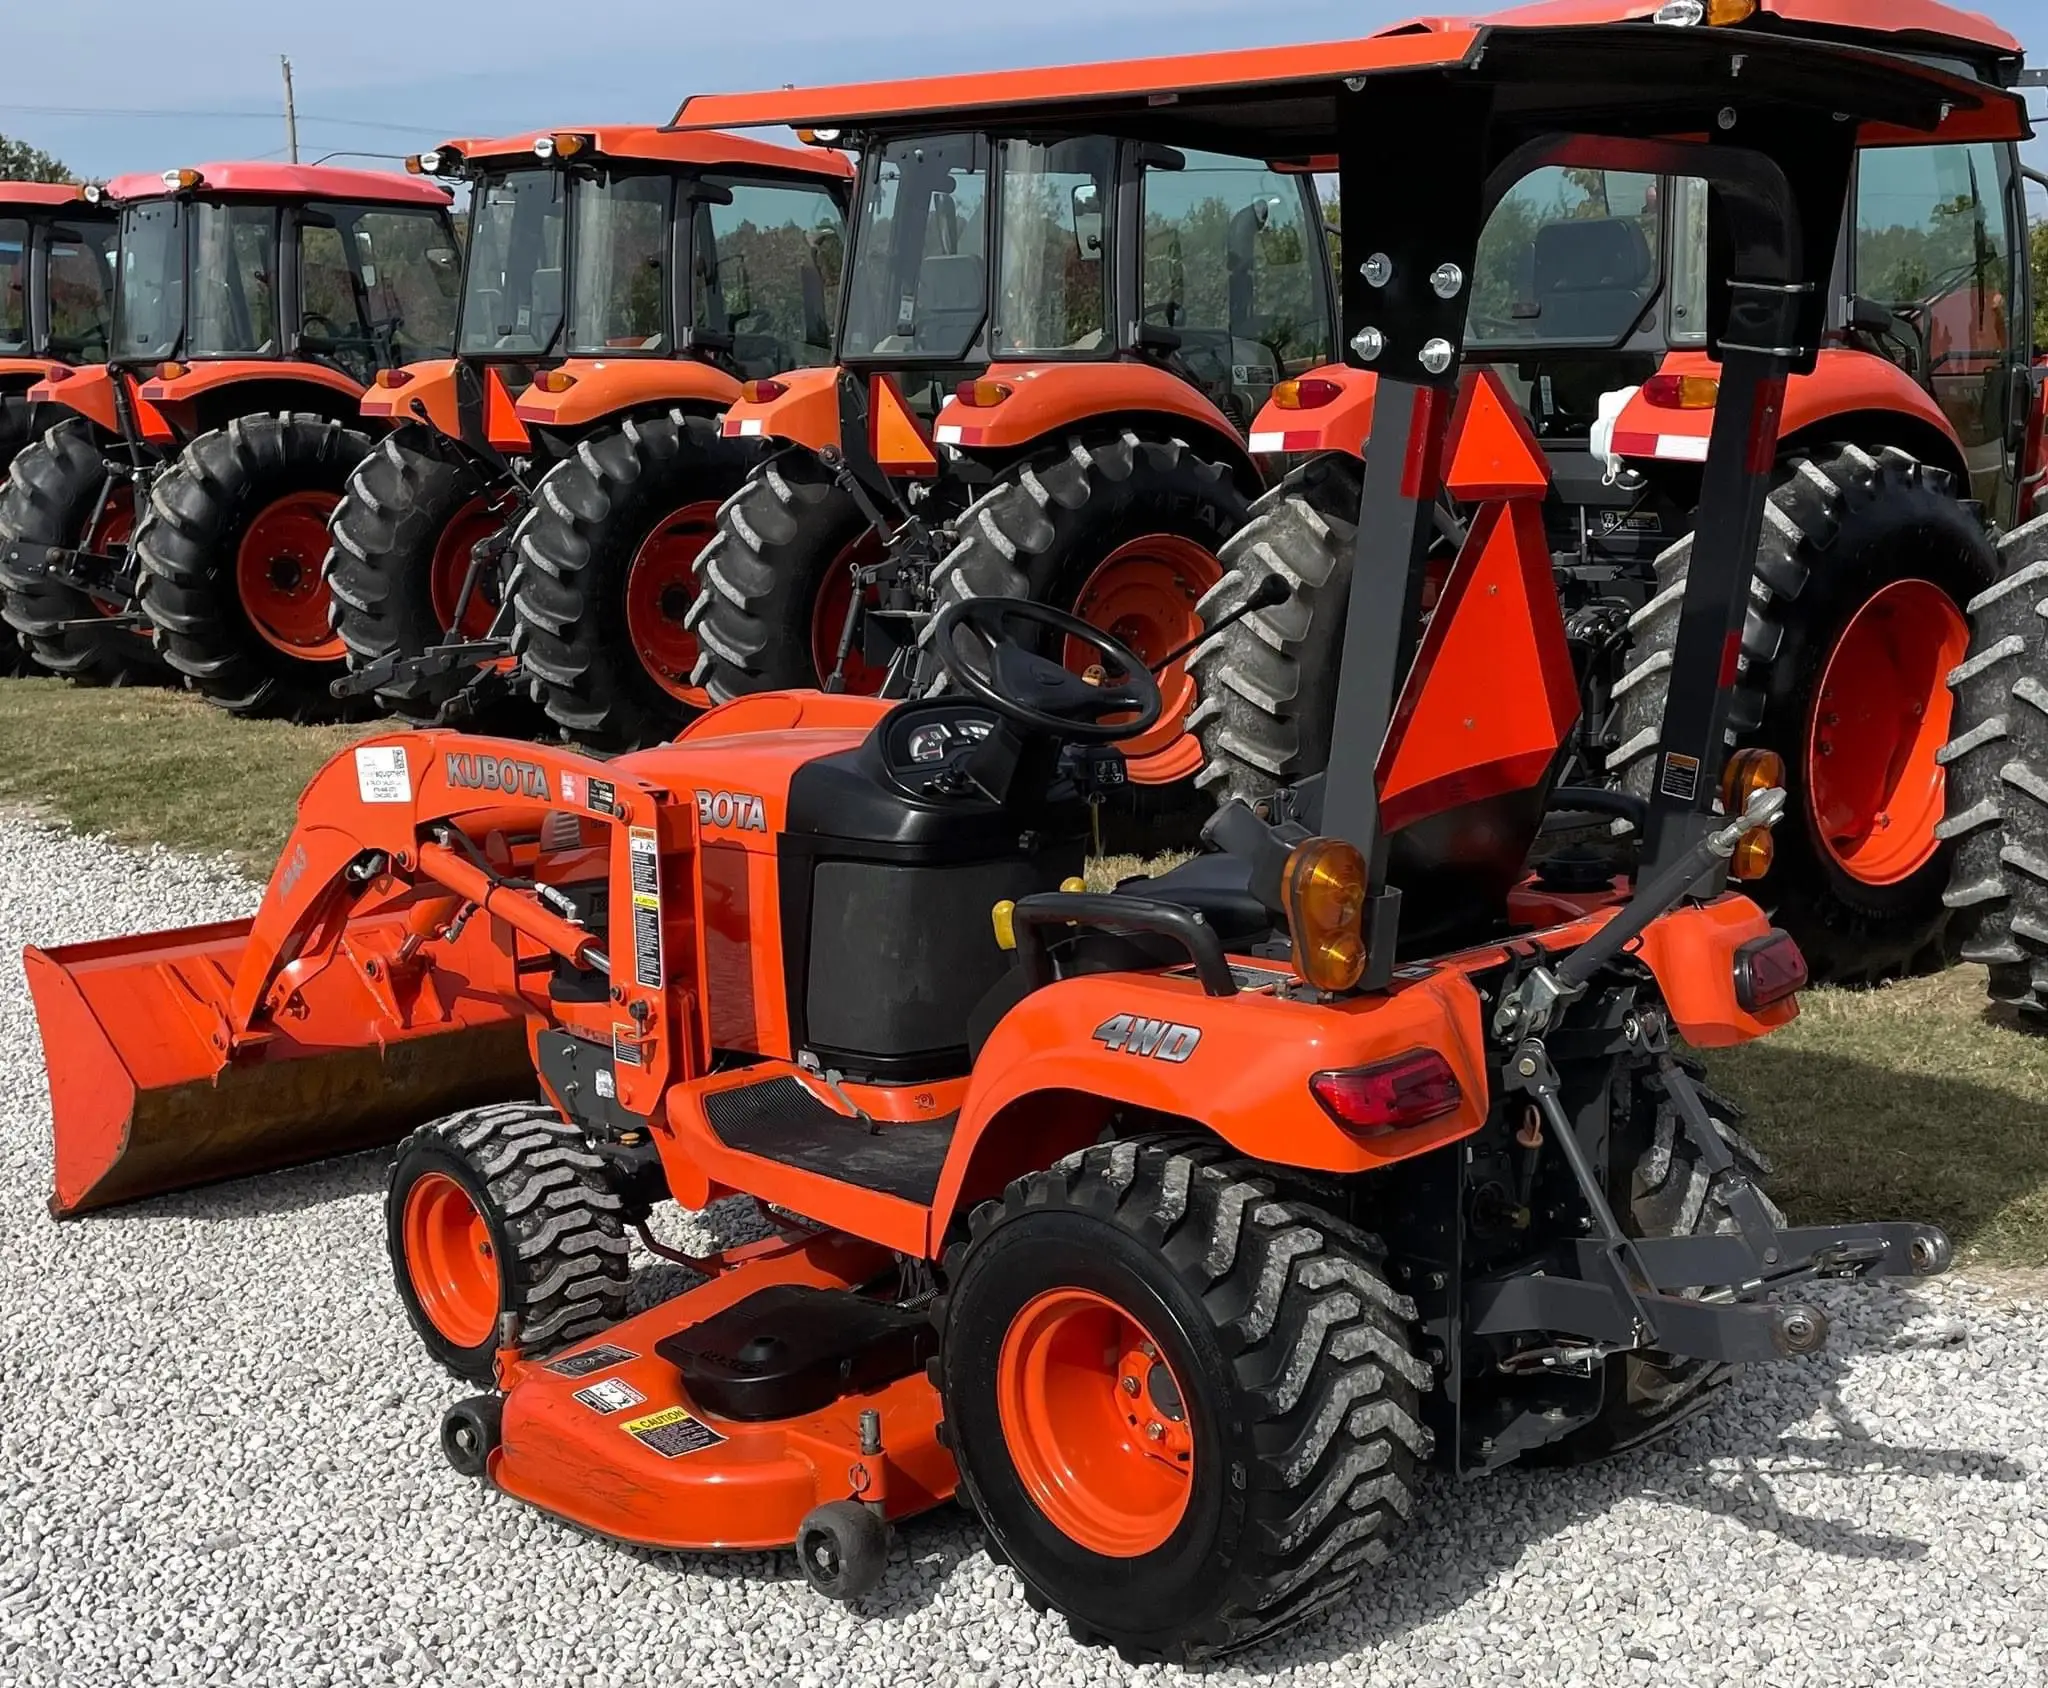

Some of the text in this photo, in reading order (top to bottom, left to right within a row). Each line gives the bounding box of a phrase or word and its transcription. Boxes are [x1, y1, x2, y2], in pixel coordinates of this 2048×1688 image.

[446, 753, 551, 801] KUBOTA
[693, 789, 767, 833] BOTA
[1092, 1012, 1202, 1064] 4WD
[640, 1410, 685, 1429] CAUTION
